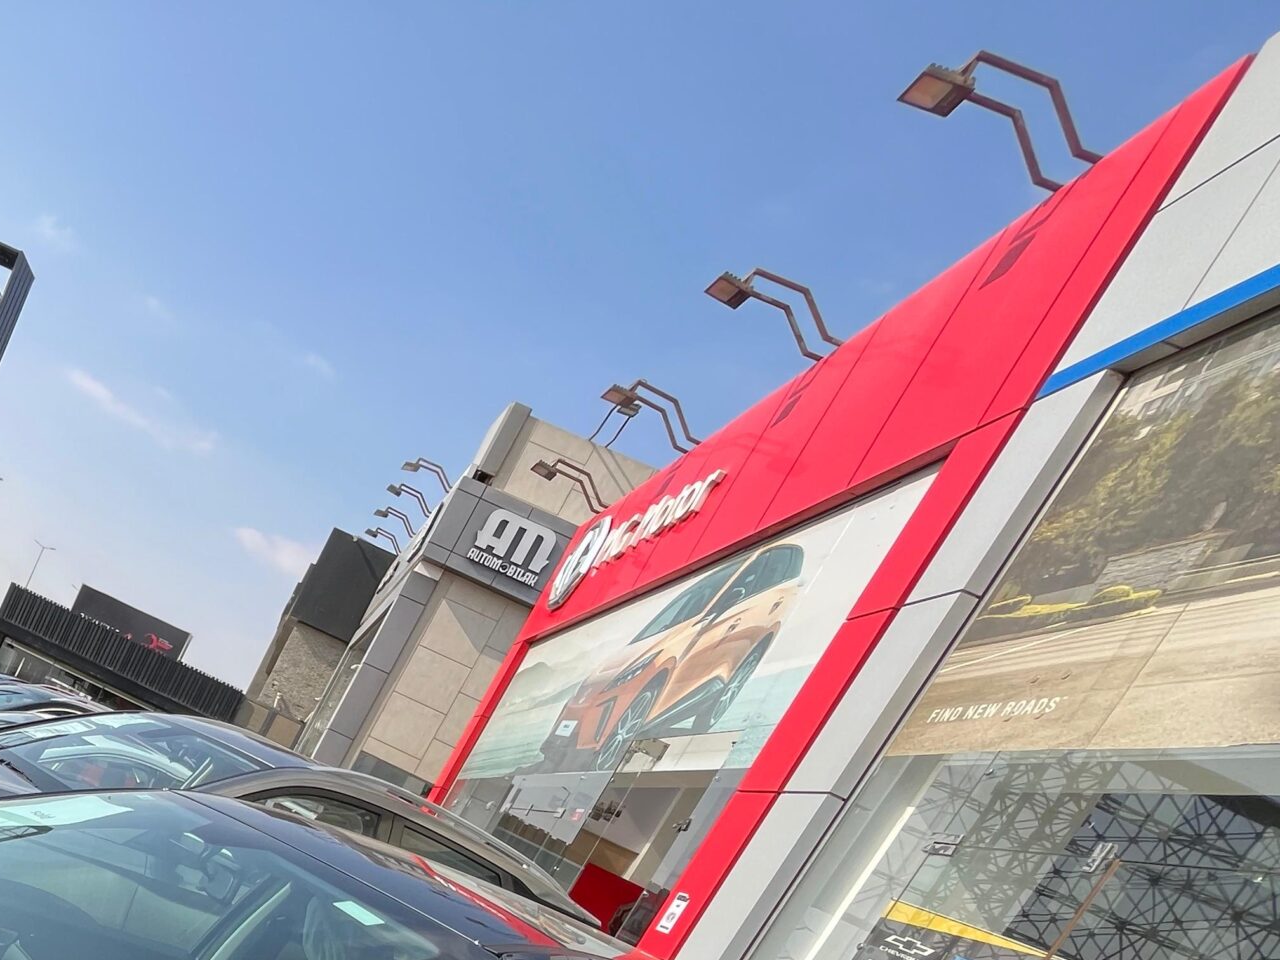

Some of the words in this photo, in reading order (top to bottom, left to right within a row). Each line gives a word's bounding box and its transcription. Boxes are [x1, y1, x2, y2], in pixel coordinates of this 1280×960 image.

[466, 547, 539, 587] AUTOMOBILAK
[927, 706, 963, 723] FIND
[962, 702, 1001, 719] NEW
[1000, 696, 1061, 717] ROADS
